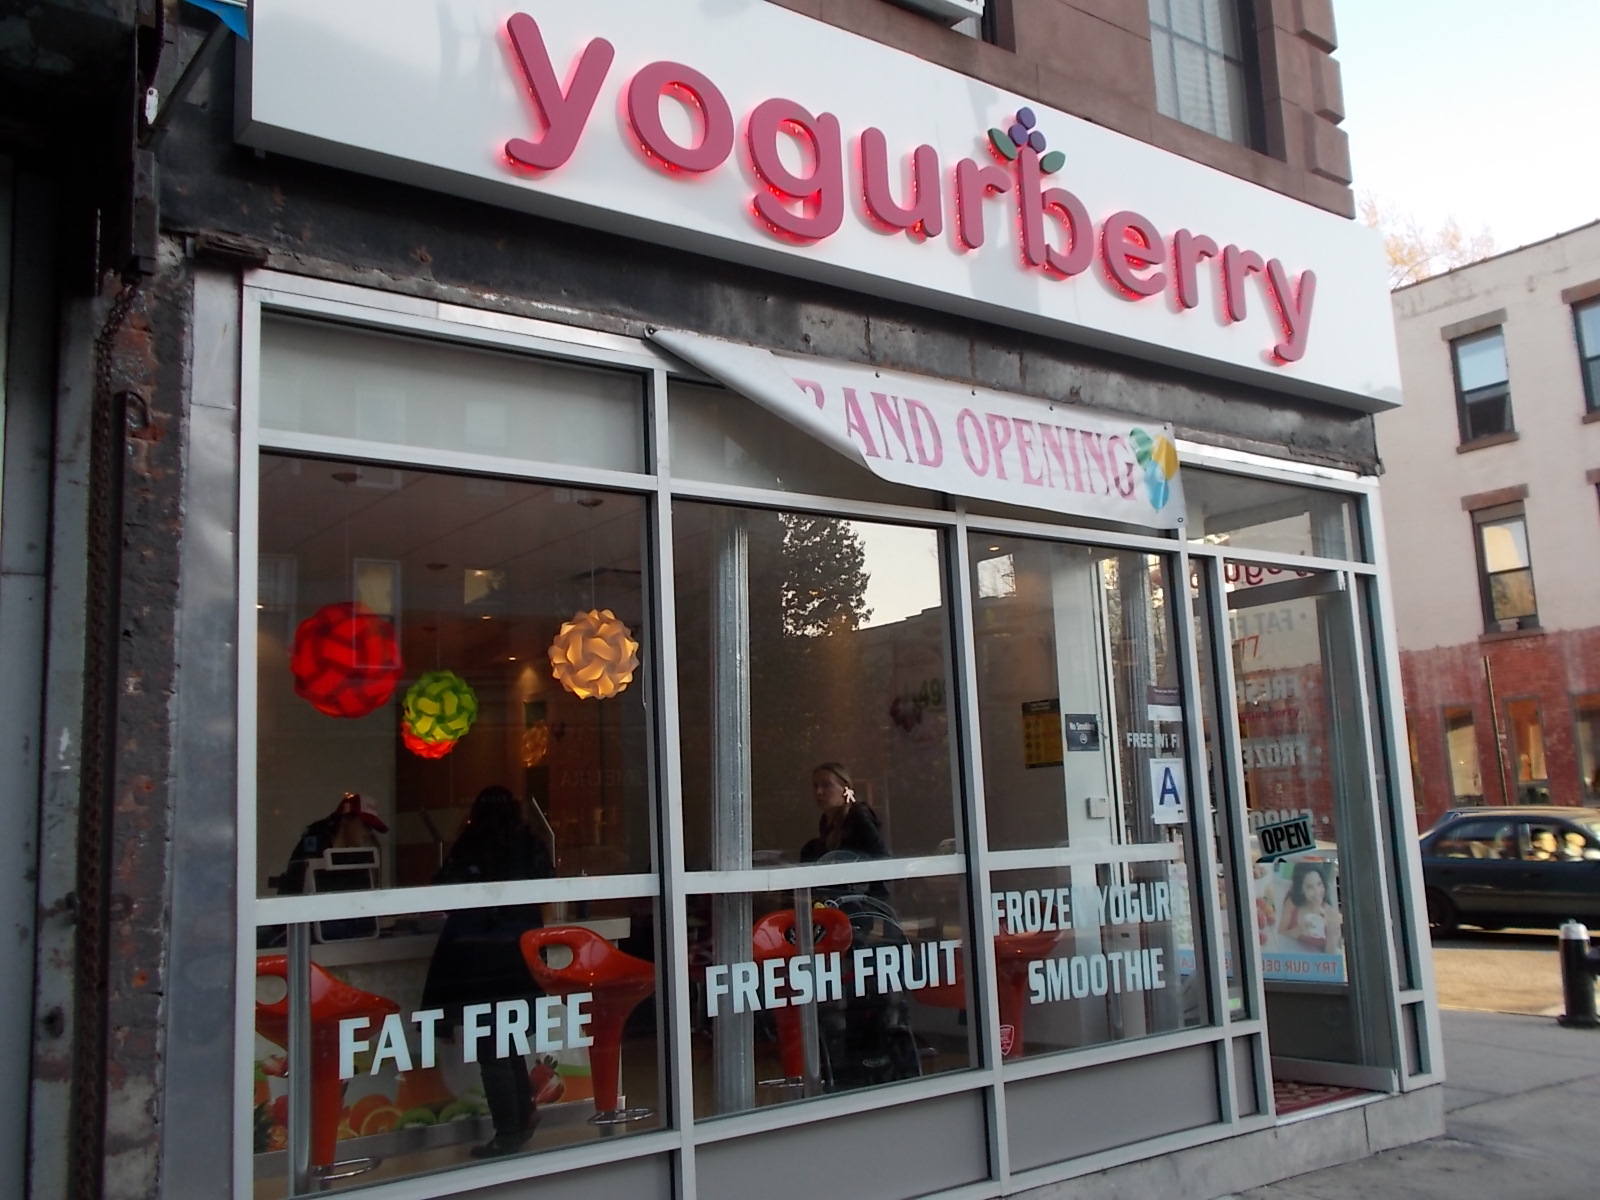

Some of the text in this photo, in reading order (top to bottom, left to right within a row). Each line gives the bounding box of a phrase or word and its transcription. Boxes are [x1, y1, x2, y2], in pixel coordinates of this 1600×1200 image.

[505, 12, 1317, 363] yogurberry
[956, 406, 1138, 501] OPENING
[1126, 732, 1180, 749] FREE Wi Fi
[1158, 766, 1181, 806] A
[1261, 821, 1312, 855] OPEN
[1094, 880, 1183, 927] YOGUR
[705, 939, 963, 1018] FRESH FRUIT
[1028, 947, 1166, 1005] SMOOTHIE
[338, 992, 594, 1080] FAT FREE
